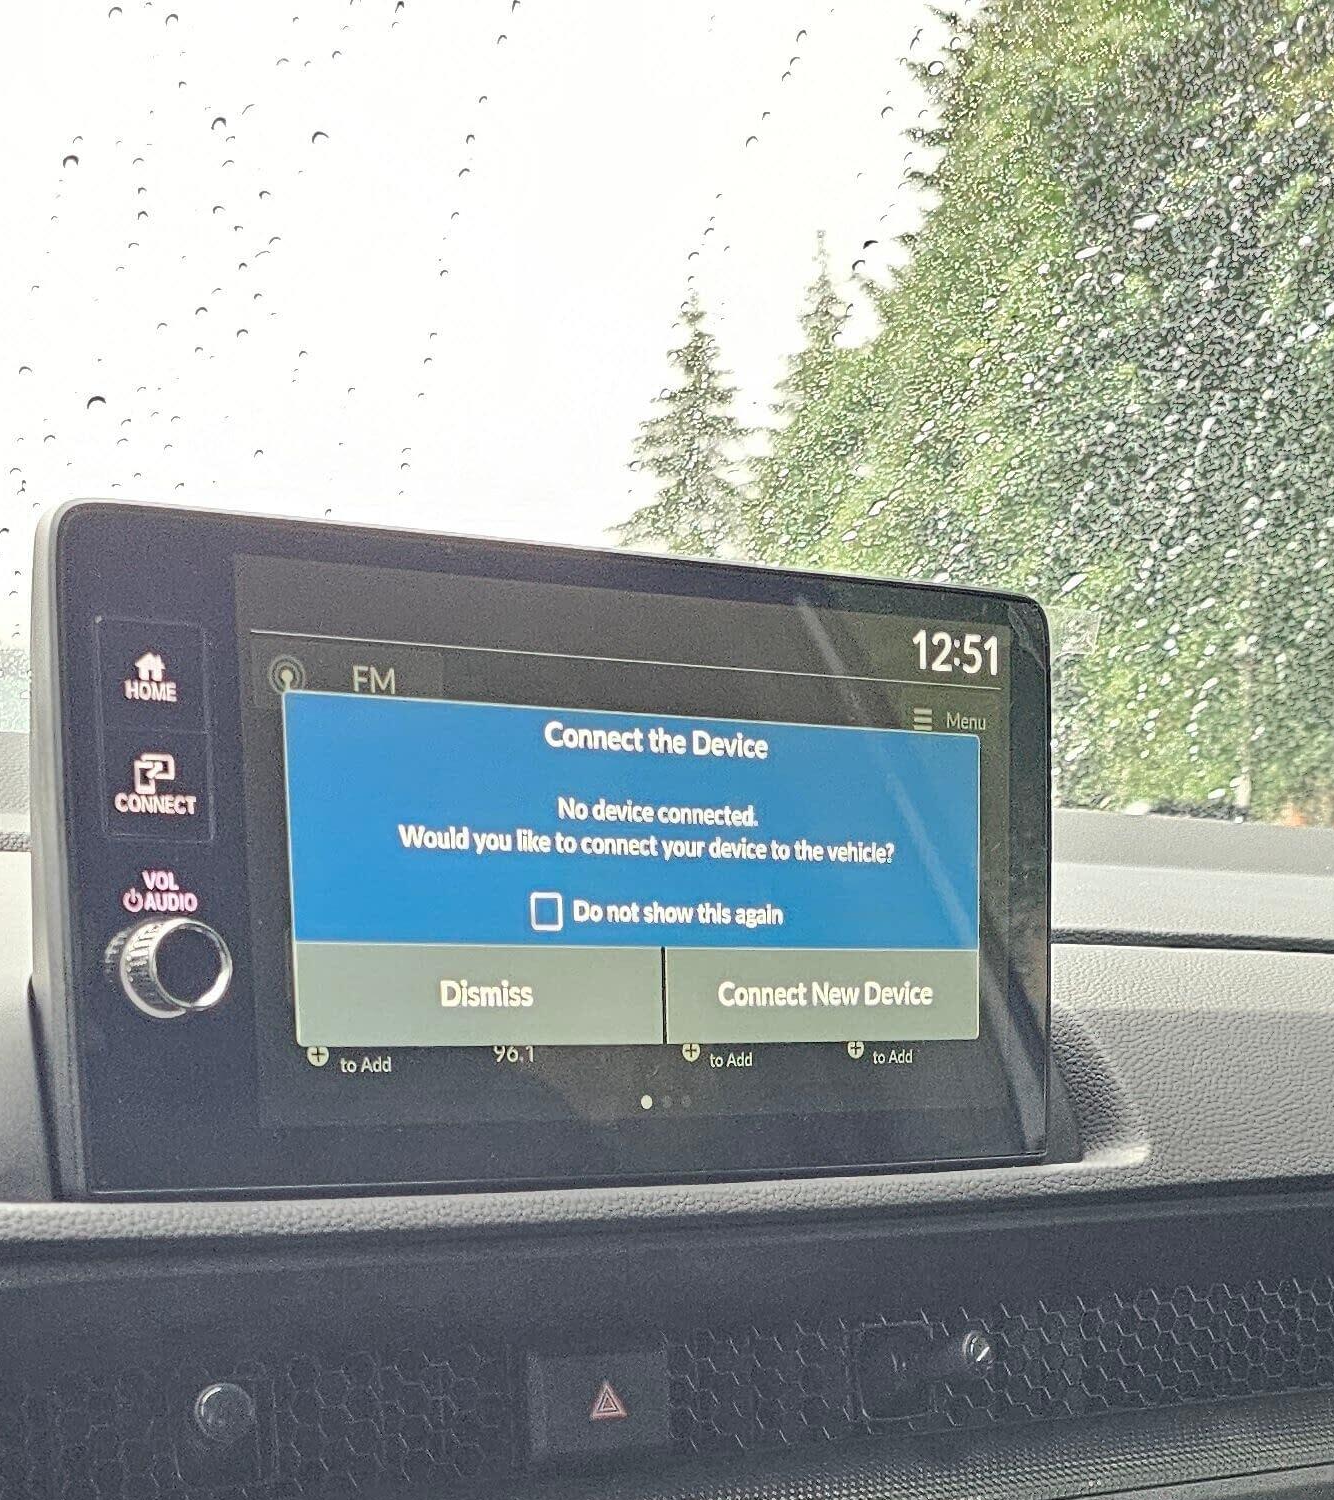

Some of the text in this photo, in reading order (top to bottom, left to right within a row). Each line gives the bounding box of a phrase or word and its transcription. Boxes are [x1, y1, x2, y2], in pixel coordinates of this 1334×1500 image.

[912, 628, 998, 676] 12:51
[124, 678, 177, 702] HOME
[352, 664, 396, 694] FM
[946, 711, 986, 730] Menu
[544, 720, 769, 760] Connect the Device
[114, 791, 197, 815] CONNECT
[557, 796, 759, 827] No device connected.
[398, 823, 895, 864] Would you like to connect your device to the vehicle?
[142, 870, 179, 891] VOL
[144, 892, 198, 912] AUDIO
[572, 899, 784, 928] Do not show this again
[440, 979, 534, 1008] Dismiss
[717, 980, 934, 1008] Connect New Device
[340, 1056, 392, 1074] to Add
[710, 1051, 753, 1067] to Add
[872, 1049, 913, 1065] to Add
